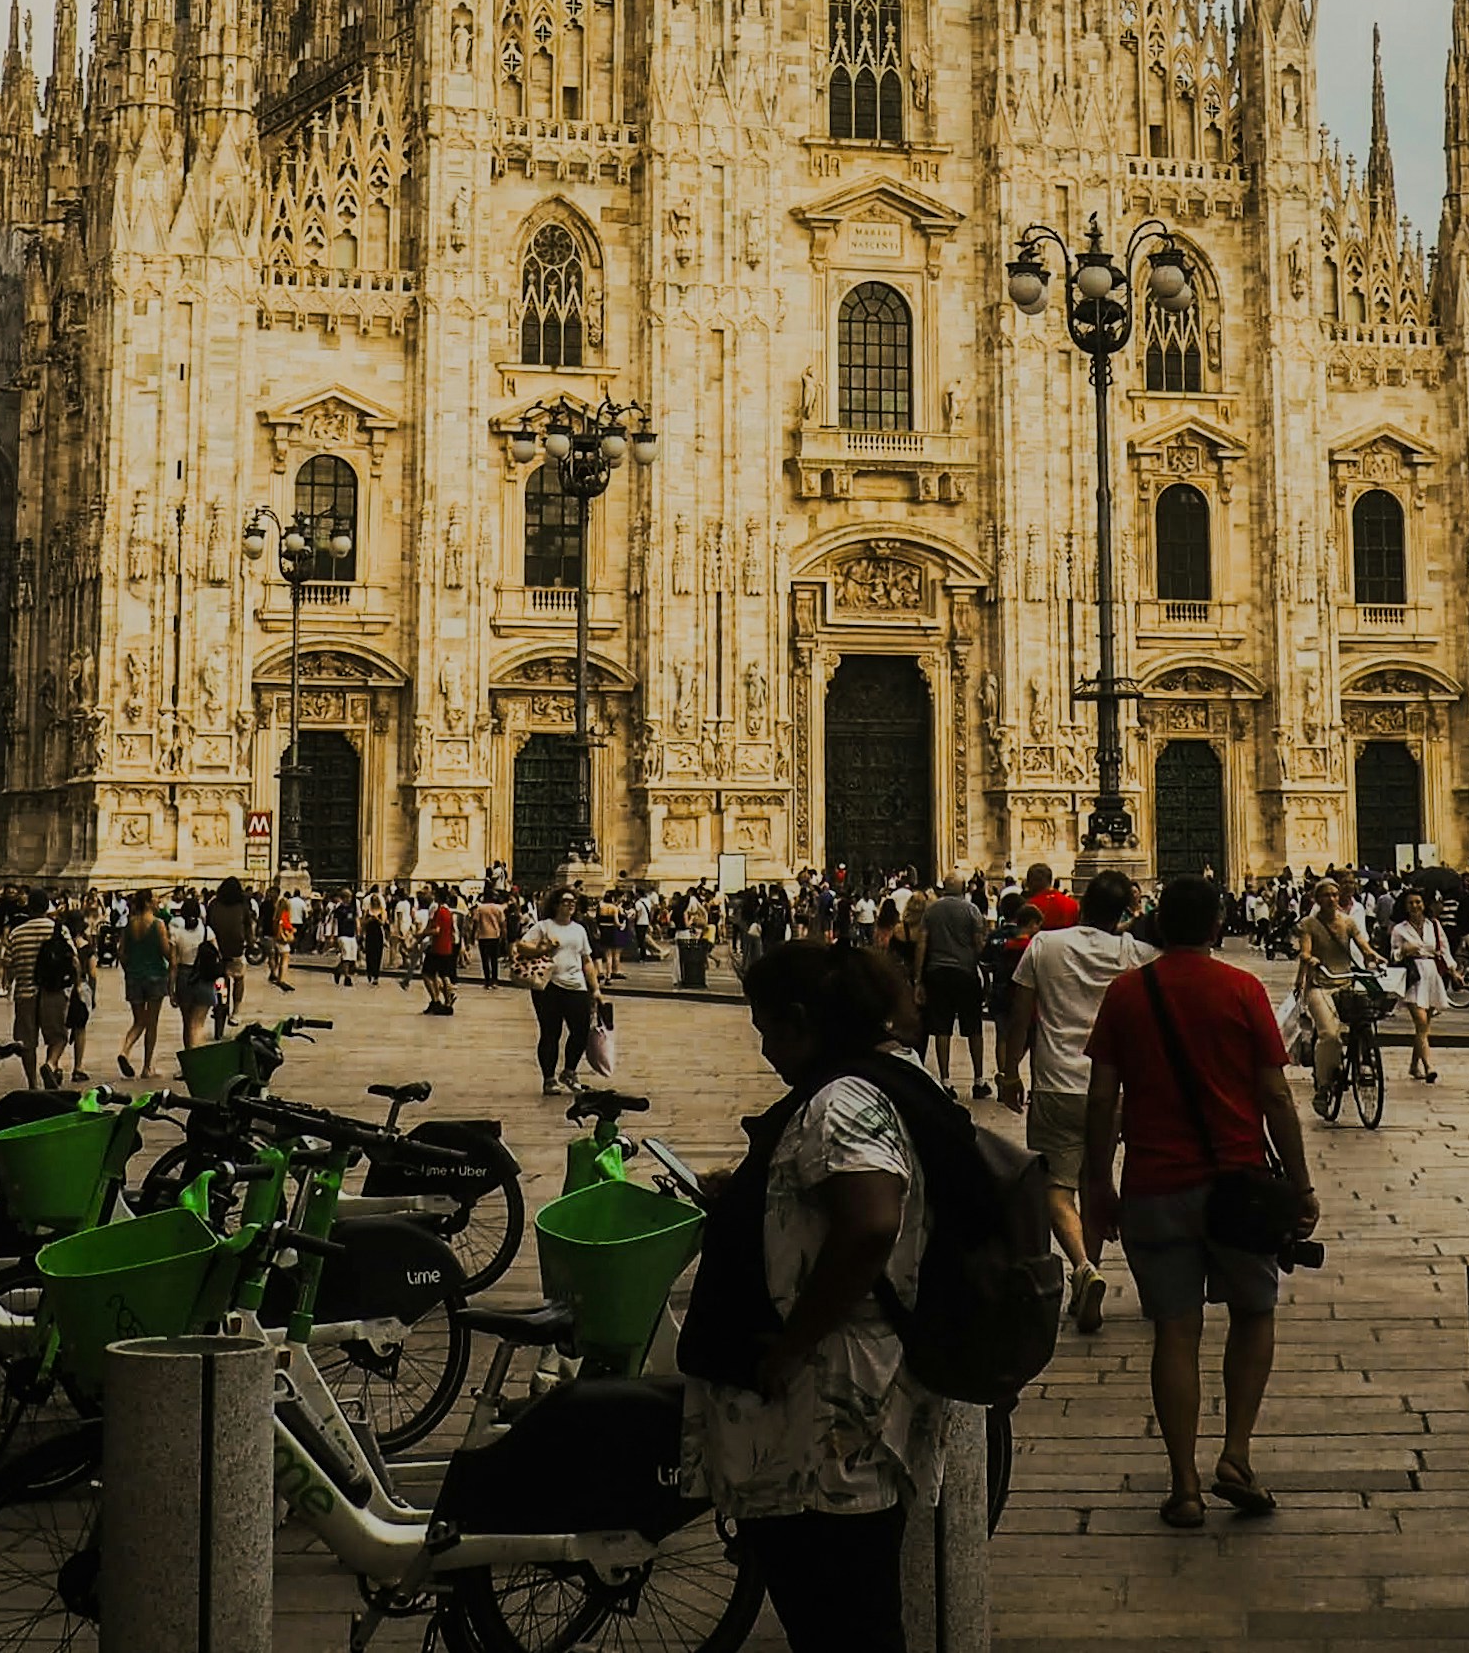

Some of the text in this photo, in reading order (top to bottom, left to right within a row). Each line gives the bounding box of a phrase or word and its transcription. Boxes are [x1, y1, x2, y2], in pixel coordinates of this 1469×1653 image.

[249, 815, 270, 833] M
[458, 1164, 488, 1177] Uber
[406, 1269, 441, 1285] Lime
